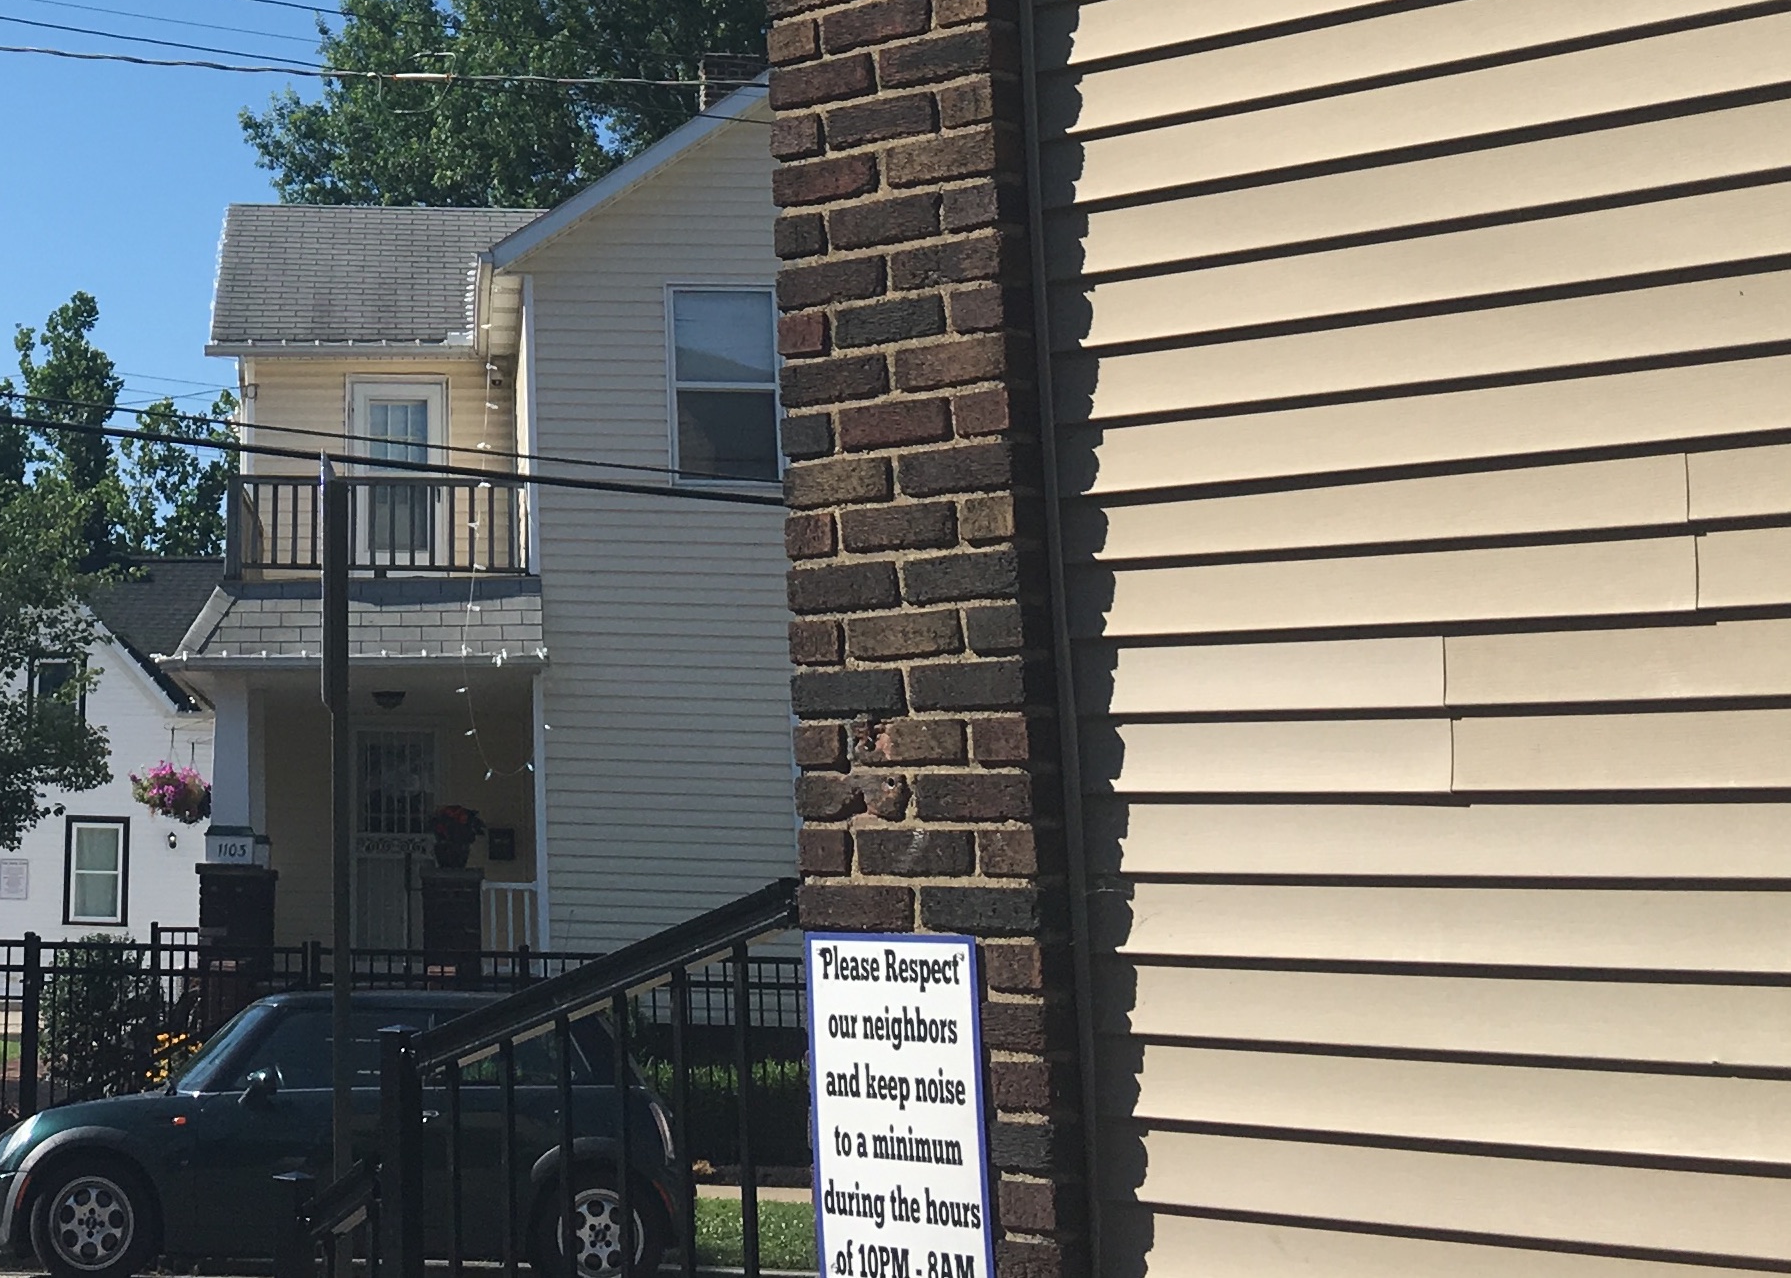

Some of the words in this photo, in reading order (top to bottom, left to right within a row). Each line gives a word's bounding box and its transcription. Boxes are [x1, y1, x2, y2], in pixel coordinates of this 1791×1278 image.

[828, 1013, 858, 1039] our
[862, 1005, 959, 1051] neighbors
[826, 1062, 861, 1098] and
[864, 1062, 910, 1111] keep
[914, 1067, 966, 1106] noise
[834, 1125, 852, 1157] to
[856, 1132, 868, 1158] a
[872, 1124, 963, 1166] minimum
[824, 1178, 885, 1229] during
[889, 1184, 921, 1224] the
[924, 1187, 981, 1230] hours
[836, 1239, 854, 1277] of
[858, 1243, 910, 1278] 10PM
[927, 1250, 975, 1278] 8AM
